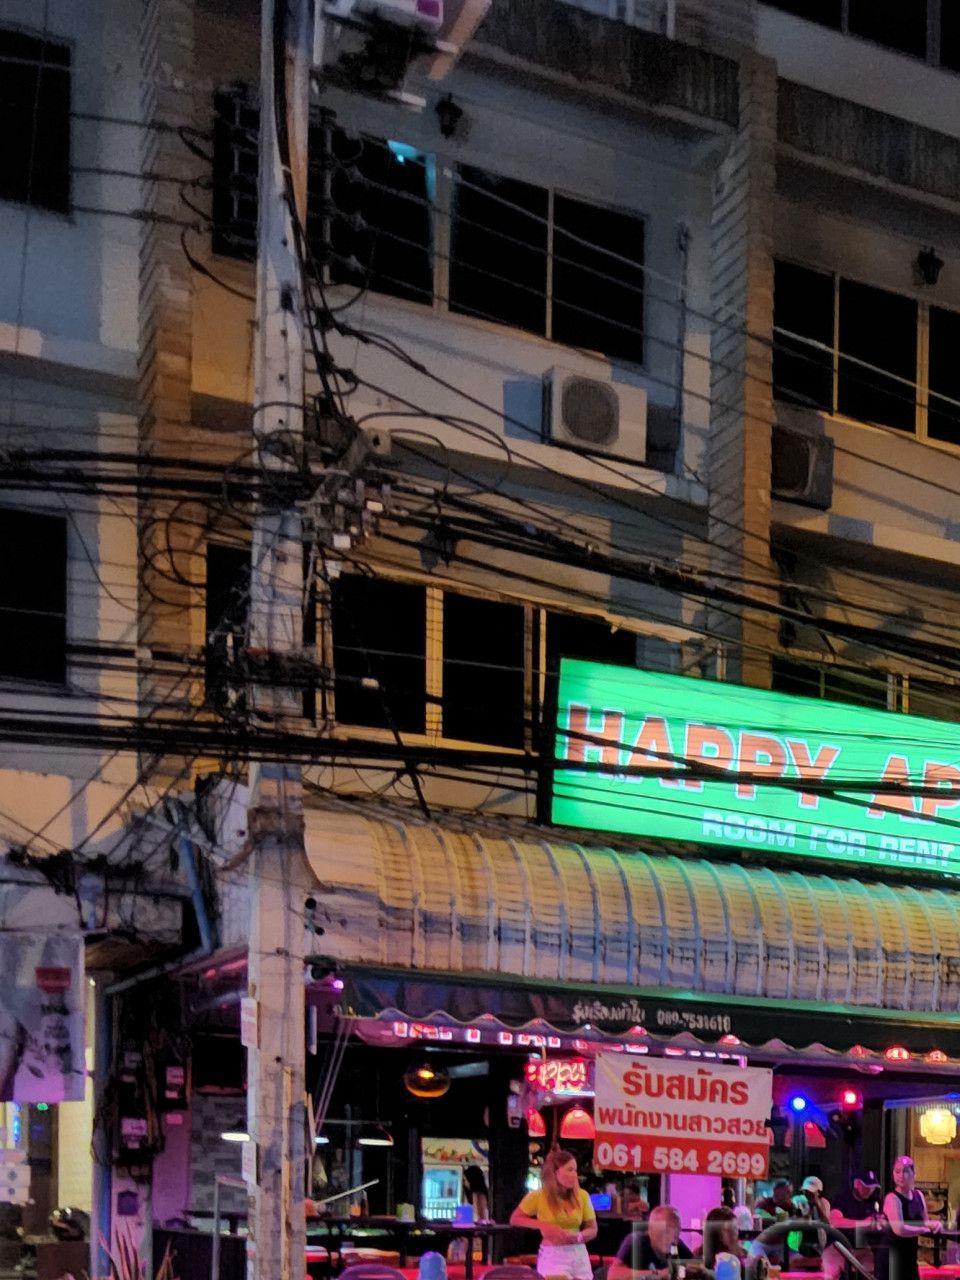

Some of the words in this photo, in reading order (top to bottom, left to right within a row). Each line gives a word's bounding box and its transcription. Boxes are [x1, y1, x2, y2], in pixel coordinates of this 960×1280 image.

[563, 703, 841, 809] HAPPY
[701, 810, 796, 849] ROOM
[810, 825, 866, 857] FOR
[879, 838, 954, 867] RENT
[622, 1061, 749, 1106] รับสมัคร
[598, 1102, 768, 1138] พนักงานสาวสวย
[597, 1142, 642, 1168] 061
[653, 1146, 699, 1172] 584
[707, 1150, 766, 1175] 2699
